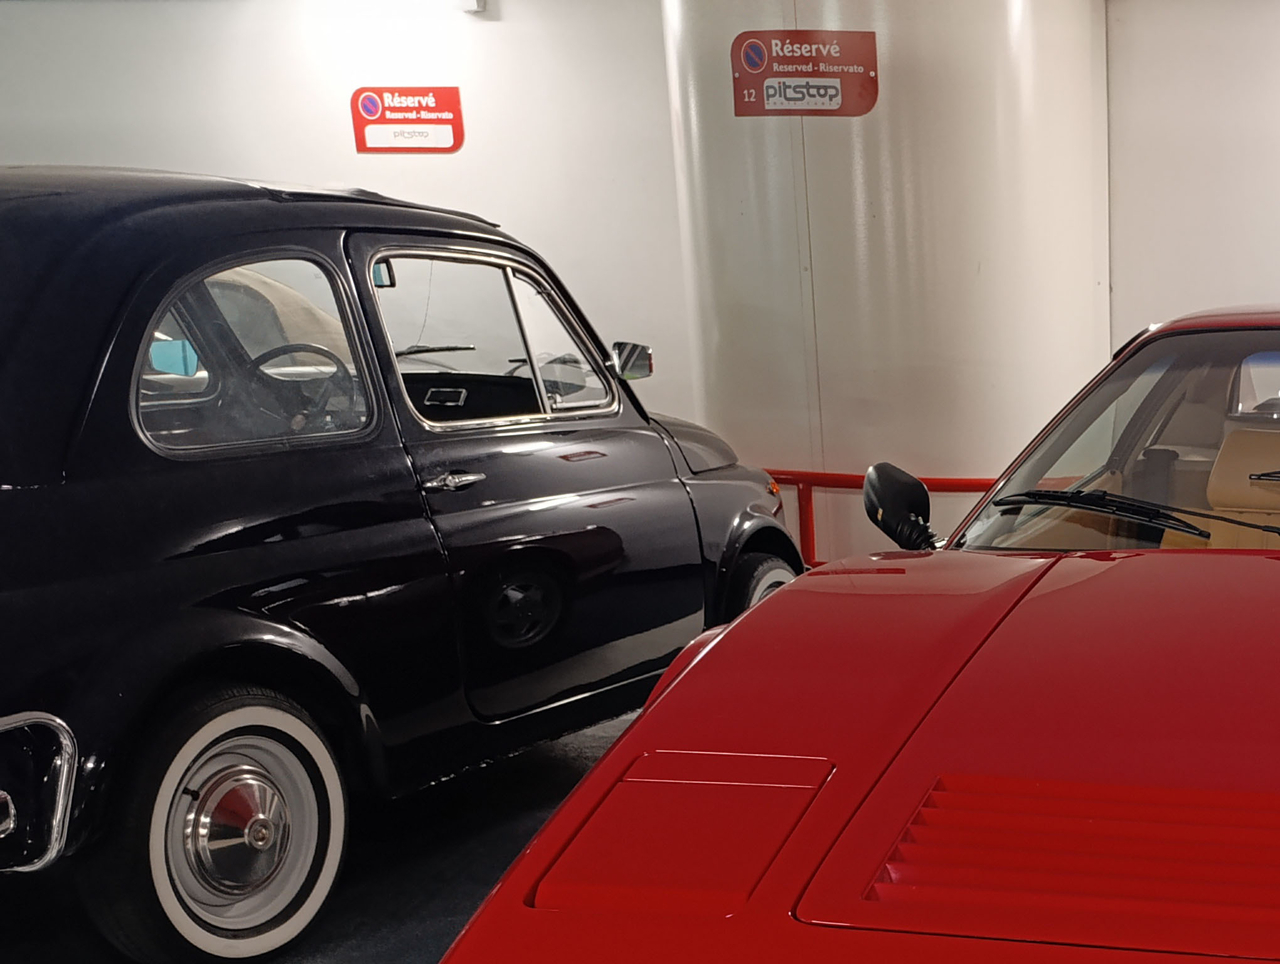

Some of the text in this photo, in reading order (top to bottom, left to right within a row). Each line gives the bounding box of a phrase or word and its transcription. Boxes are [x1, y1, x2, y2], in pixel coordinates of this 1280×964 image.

[771, 39, 841, 57] Réservé
[773, 62, 813, 72] Reserved
[819, 63, 864, 73] Riservato
[743, 89, 756, 102] 12
[765, 81, 840, 102] pitstop
[383, 92, 436, 107] Réservé
[385, 111, 417, 119] Reserved
[420, 111, 454, 119] Riservato
[393, 130, 429, 139] pitstop
